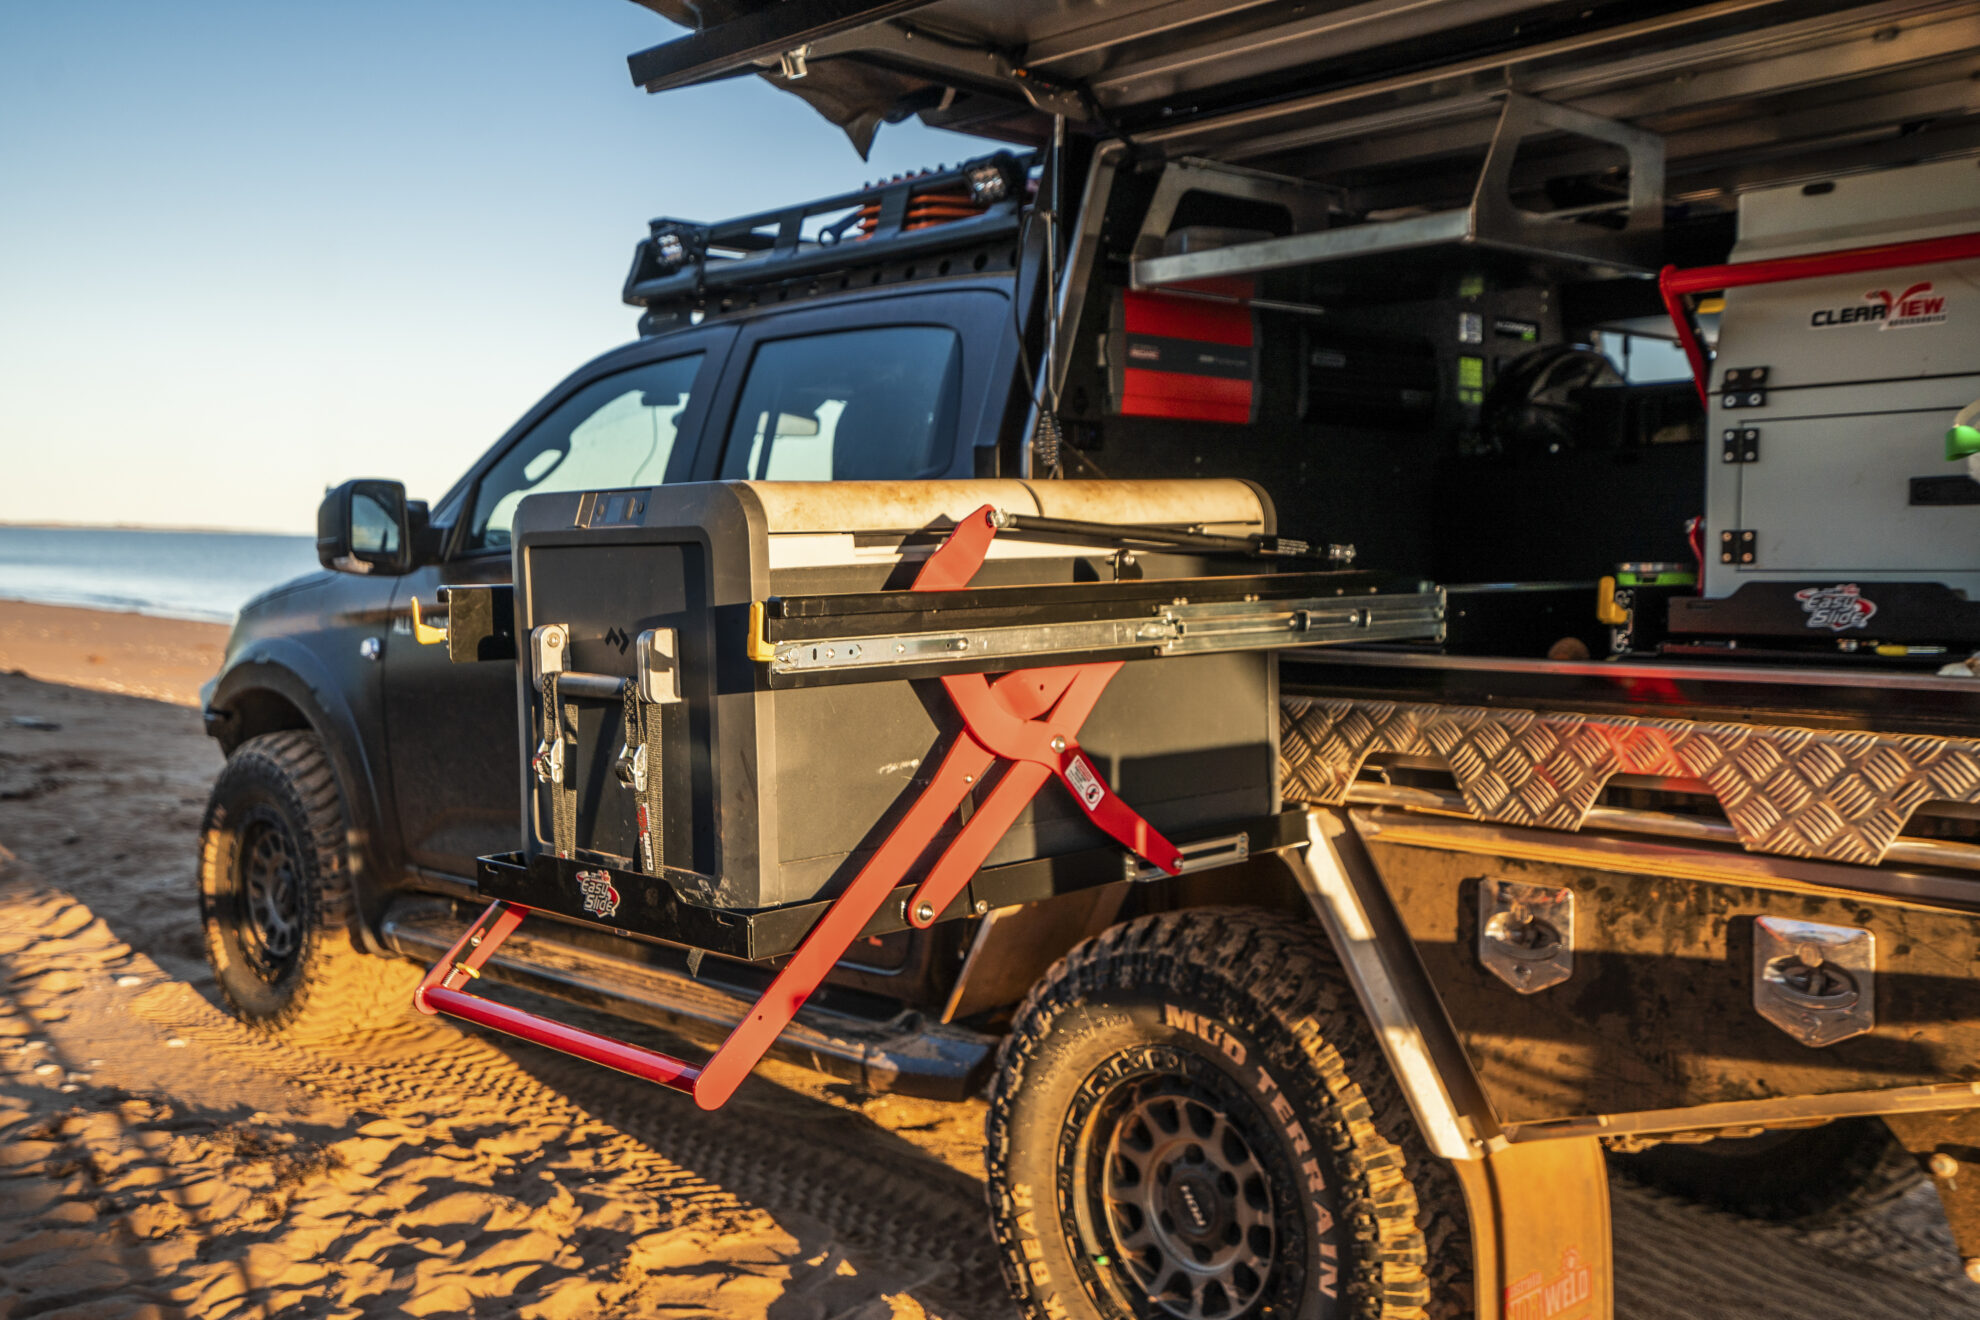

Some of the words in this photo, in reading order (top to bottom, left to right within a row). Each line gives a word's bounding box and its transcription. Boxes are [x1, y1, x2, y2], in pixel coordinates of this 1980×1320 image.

[1807, 591, 1858, 611] Easy
[1813, 607, 1866, 625] Slide
[581, 876, 610, 899] Easy
[584, 894, 614, 912] Slide
[1164, 1003, 1248, 1066] MUD
[1256, 1065, 1338, 1300] TERRAIN
